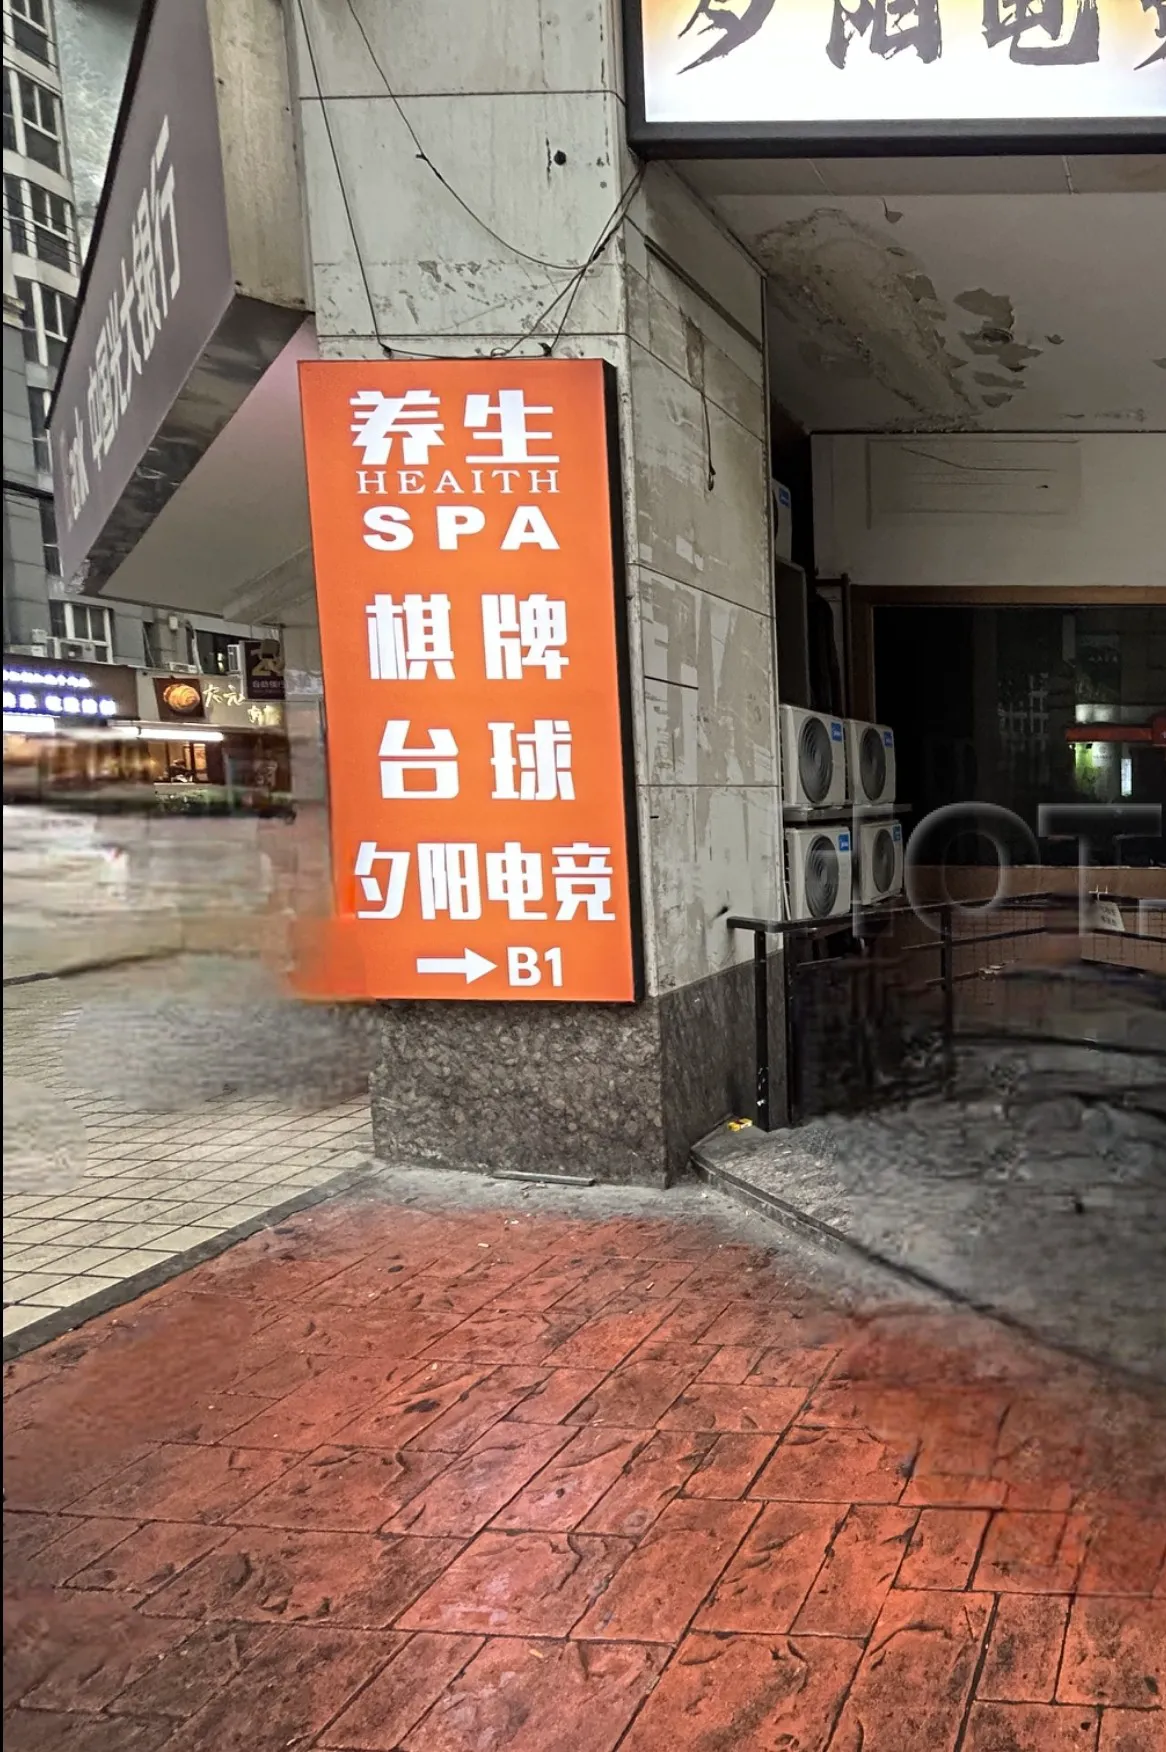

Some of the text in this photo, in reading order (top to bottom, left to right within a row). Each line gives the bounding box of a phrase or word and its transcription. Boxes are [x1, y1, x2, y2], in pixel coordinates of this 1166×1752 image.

[350, 389, 561, 465] 养生
[356, 469, 560, 494] HEAITH
[363, 505, 561, 551] SPA
[366, 594, 570, 680] 棋牌
[378, 719, 576, 800] 台球
[354, 842, 616, 921] 夕阳电竞
[507, 946, 564, 988] B1
